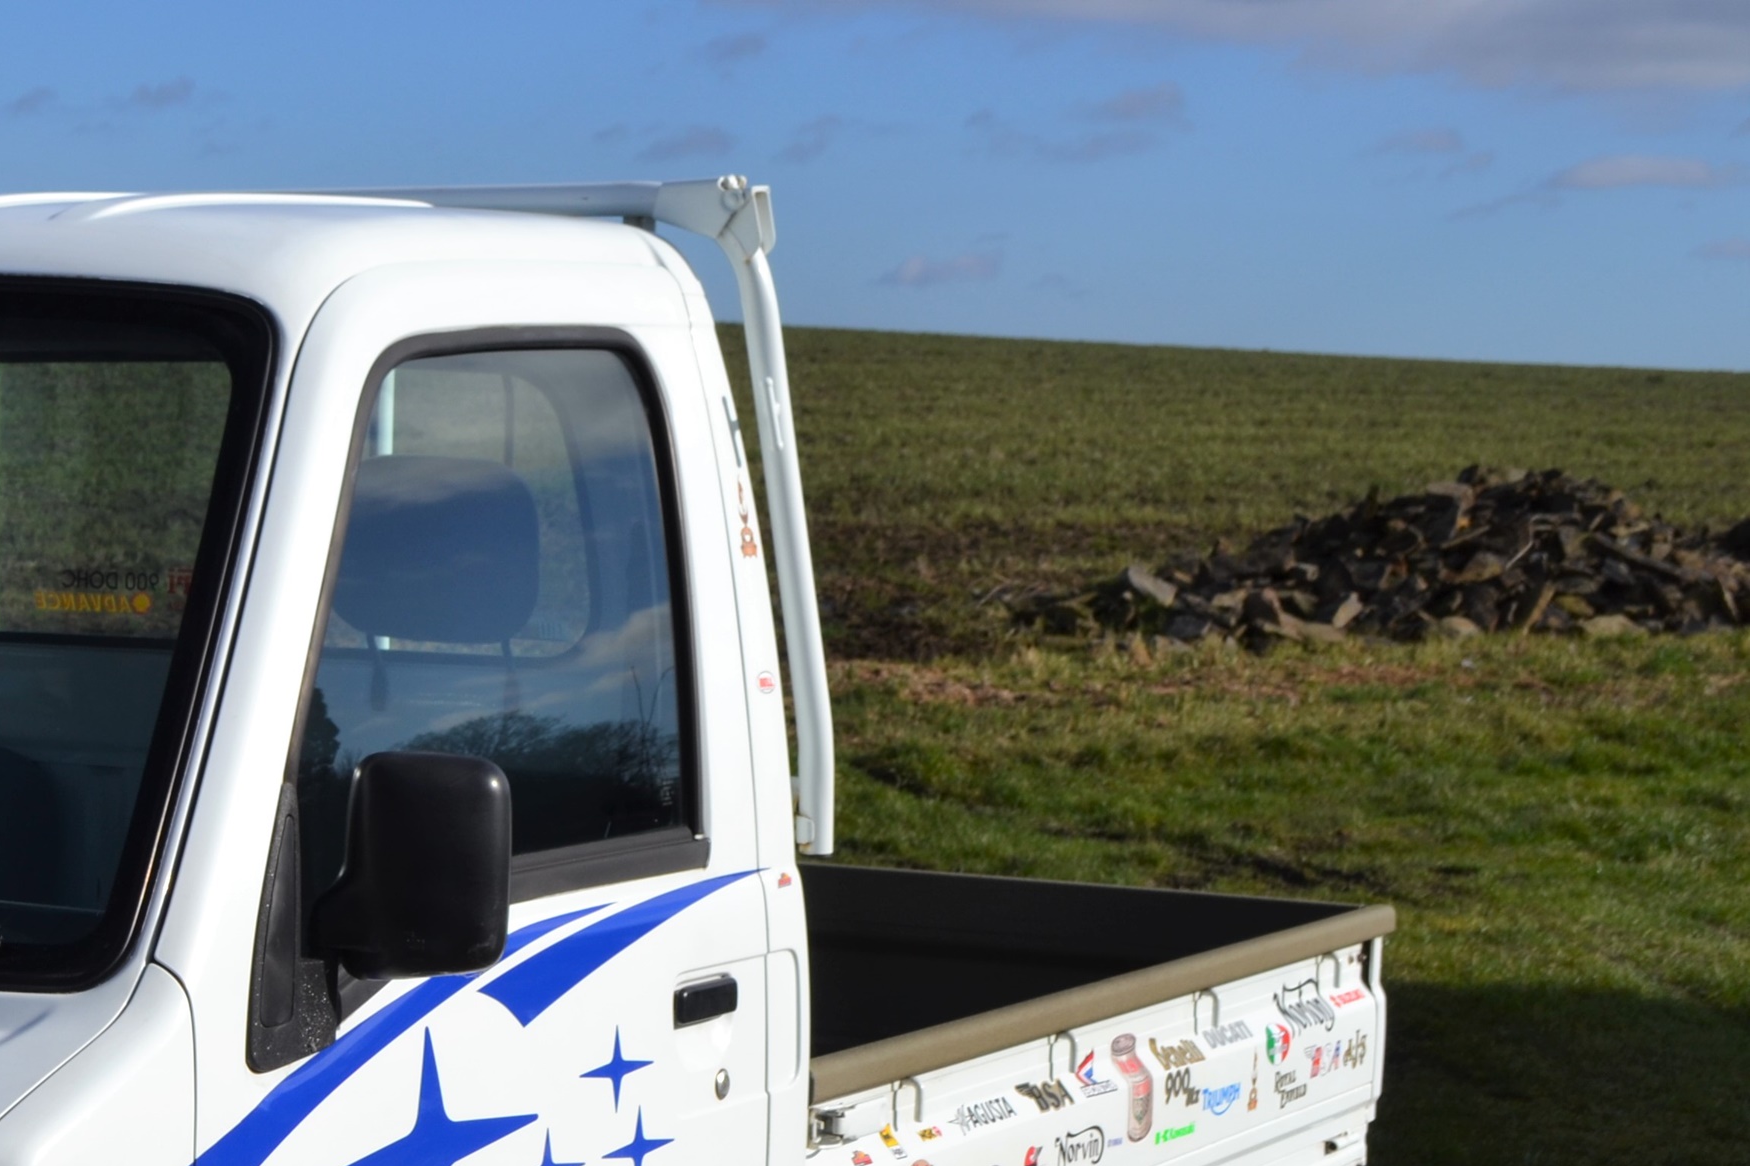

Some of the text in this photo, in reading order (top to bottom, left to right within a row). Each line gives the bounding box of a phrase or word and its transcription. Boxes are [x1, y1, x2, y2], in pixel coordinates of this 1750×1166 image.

[1202, 1020, 1253, 1049] DUCATI
[1027, 1078, 1075, 1113] BSA
[1165, 1067, 1191, 1105] 900
[966, 1096, 1017, 1129] AGUSTA
